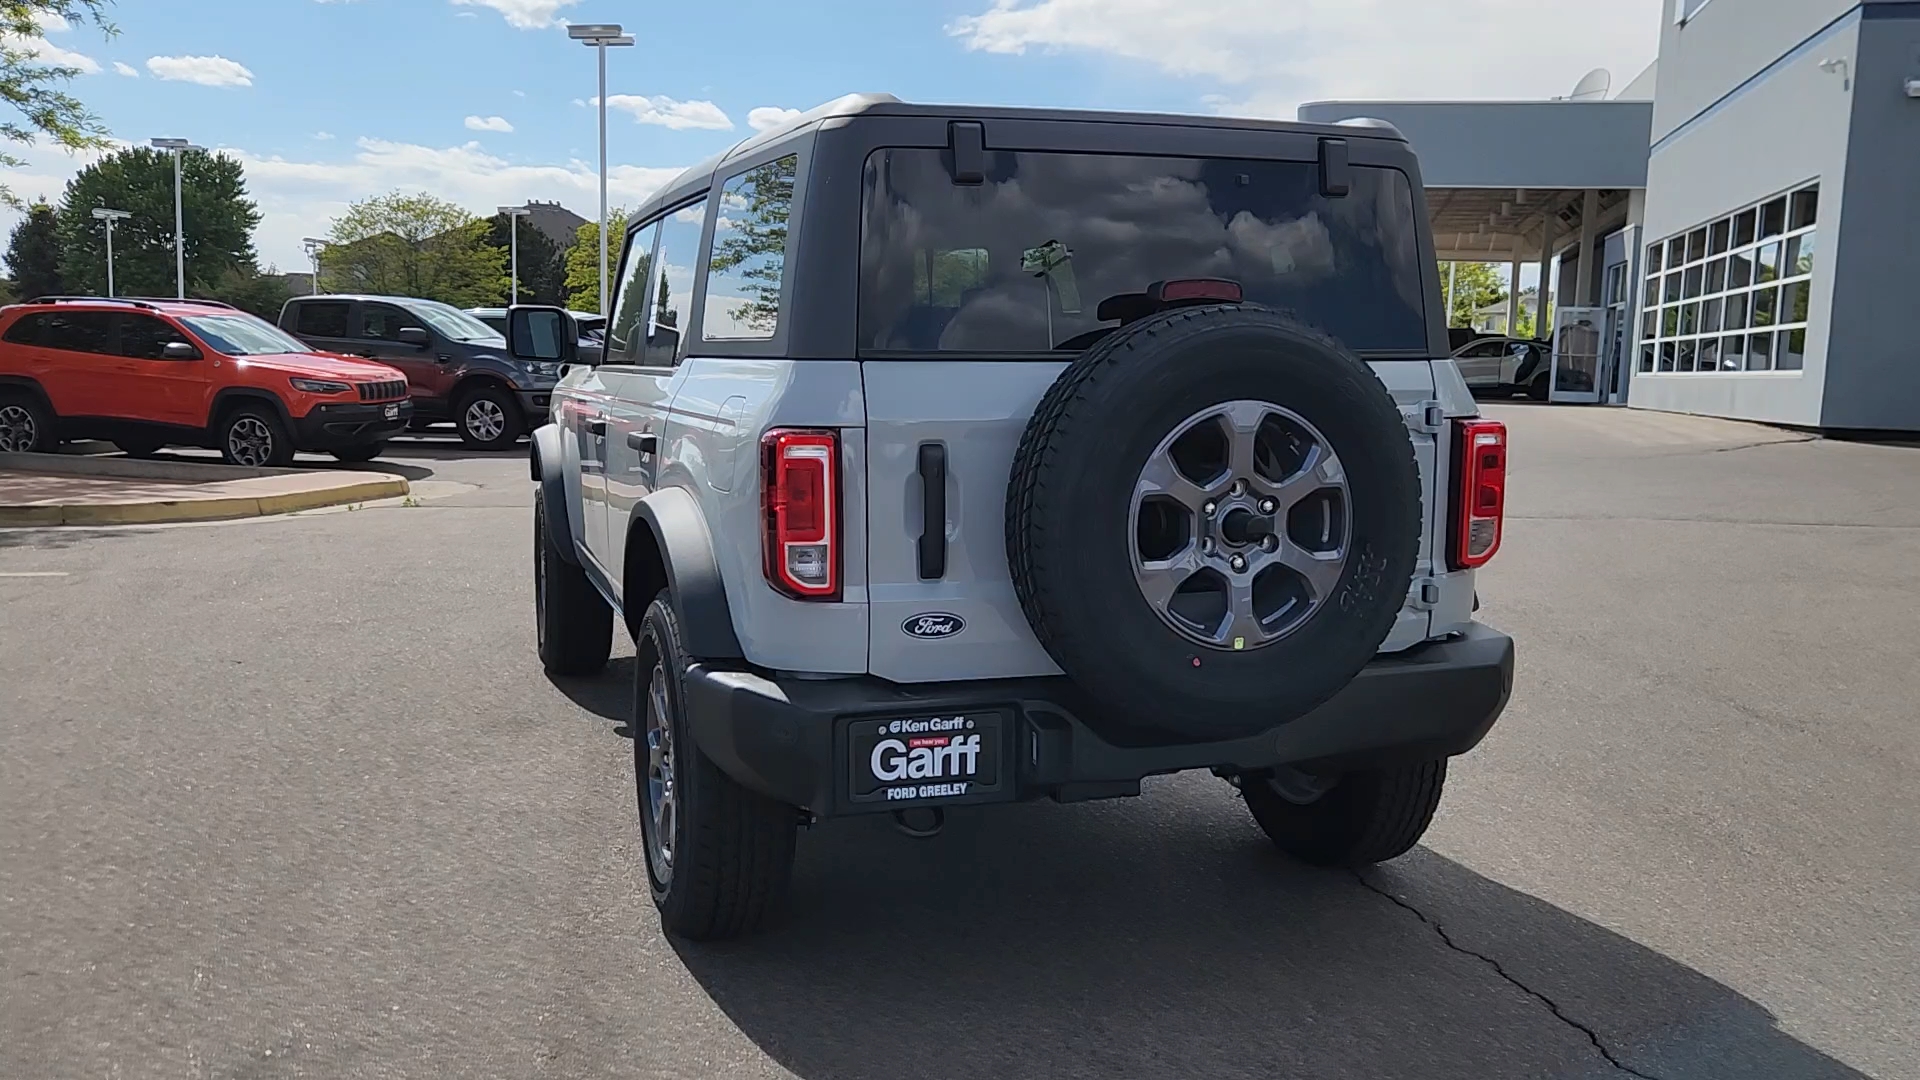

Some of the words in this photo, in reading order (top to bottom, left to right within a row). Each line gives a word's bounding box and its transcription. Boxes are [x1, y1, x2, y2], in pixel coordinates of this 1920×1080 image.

[914, 617, 954, 634] Ford
[902, 719, 929, 733] Ken
[930, 716, 965, 731] Garff
[871, 734, 981, 781] Garff
[887, 786, 917, 801] FORD
[919, 782, 968, 798] GREELEY
